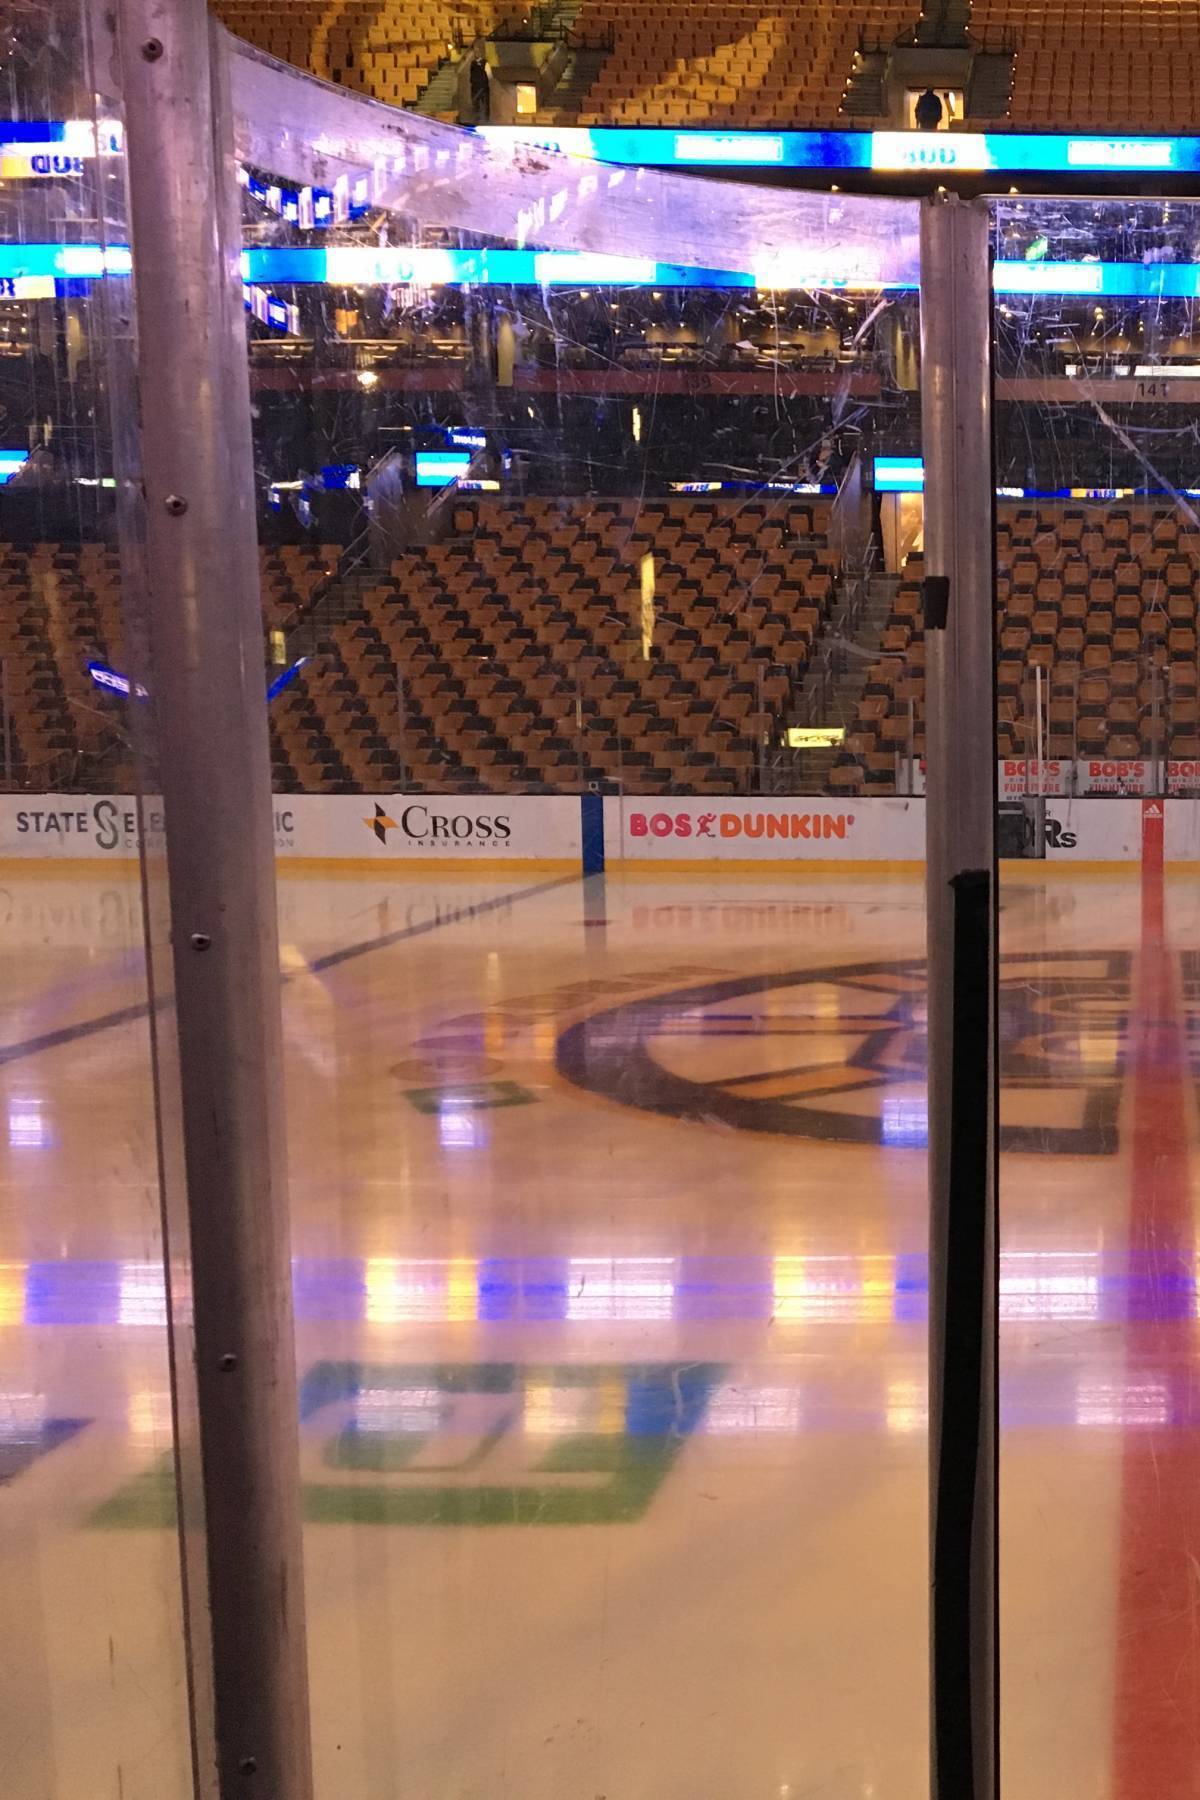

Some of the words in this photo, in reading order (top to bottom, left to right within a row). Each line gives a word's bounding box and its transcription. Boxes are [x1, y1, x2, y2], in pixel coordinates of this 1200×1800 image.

[1138, 382, 1168, 398] 141
[1089, 762, 1144, 777] BOB'S
[16, 811, 88, 833] STATE
[630, 813, 692, 837] BOS
[720, 813, 855, 839] DUNKIN'
